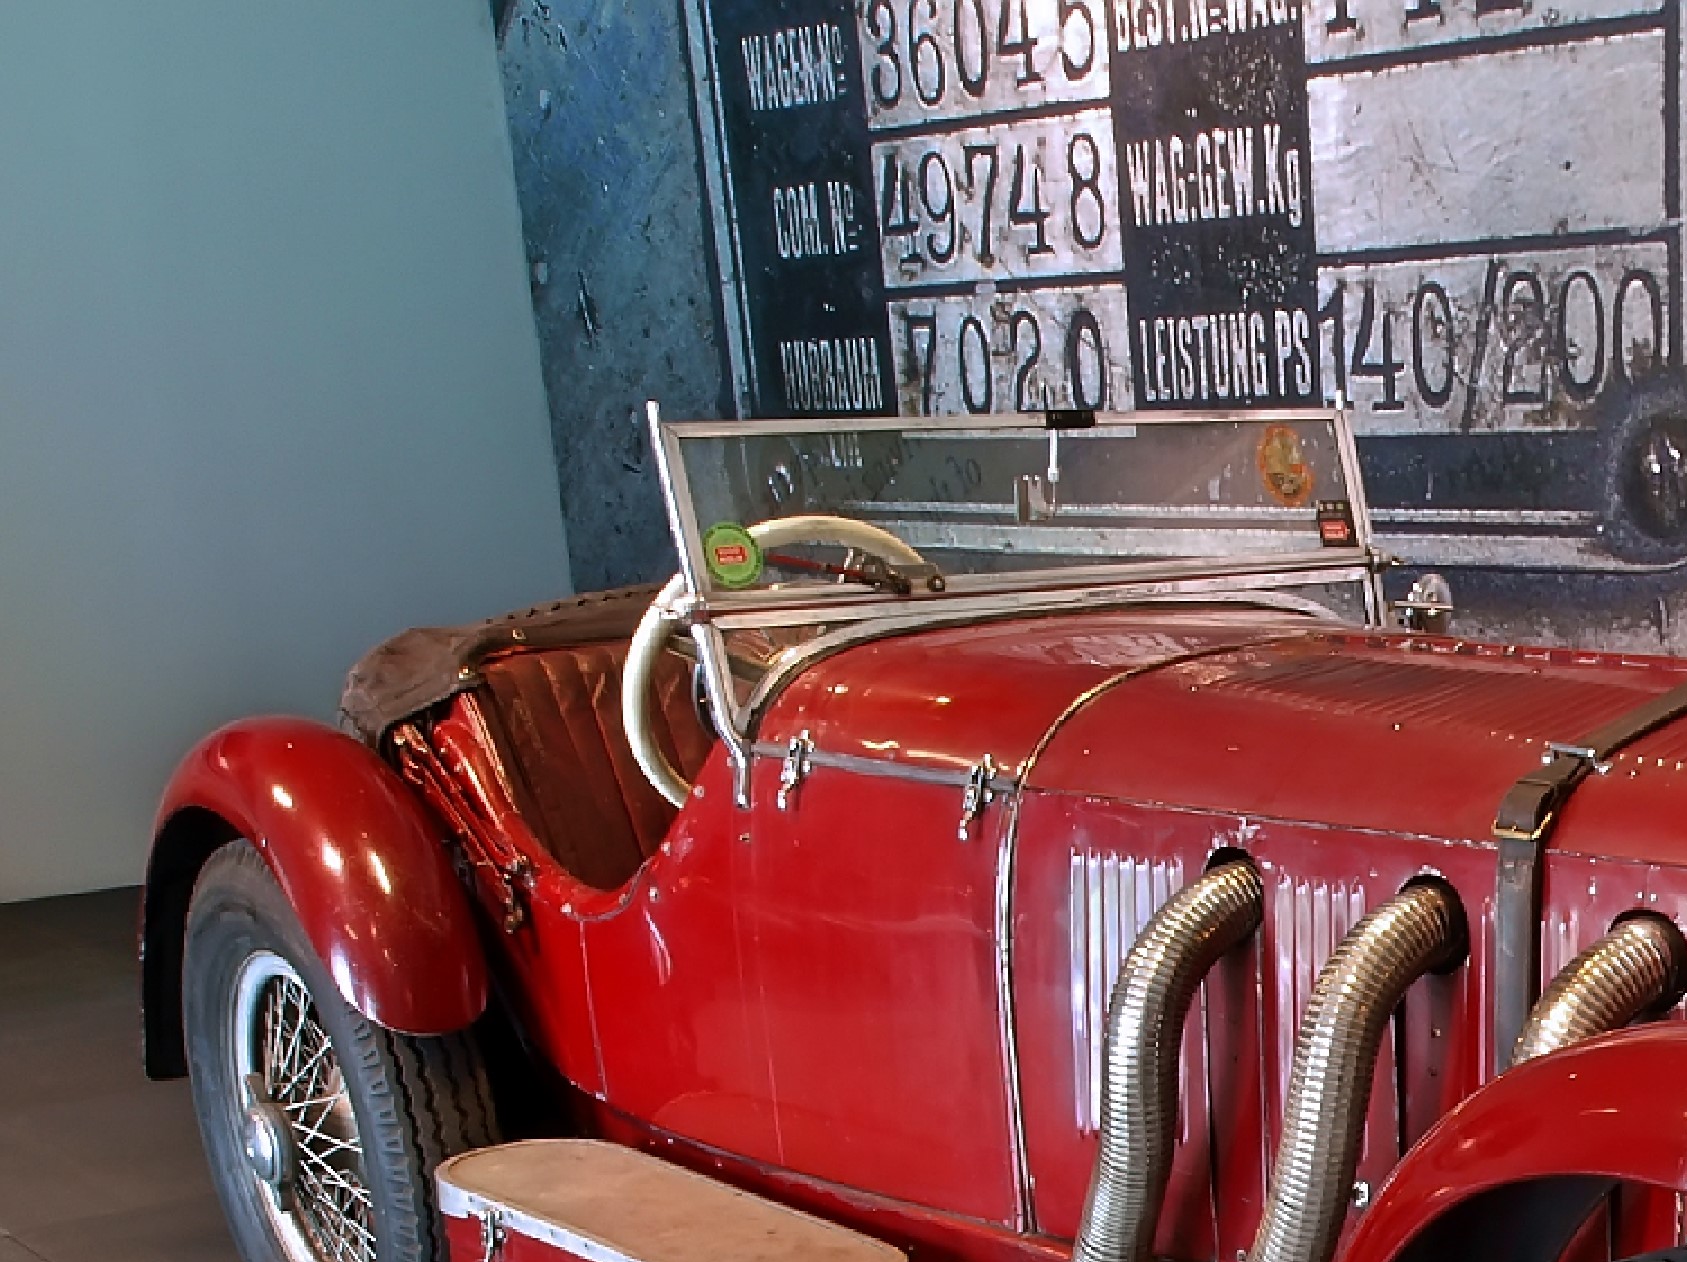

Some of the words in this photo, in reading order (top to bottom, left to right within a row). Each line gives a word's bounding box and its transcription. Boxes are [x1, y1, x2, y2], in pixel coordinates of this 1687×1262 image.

[856, 0, 1094, 110] 36045
[880, 133, 1104, 264] 49748
[907, 309, 1104, 415] 7020
[1139, 312, 1270, 401] LEISTUNG
[1274, 307, 1312, 397] PS
[1318, 253, 1661, 434] 140/200
